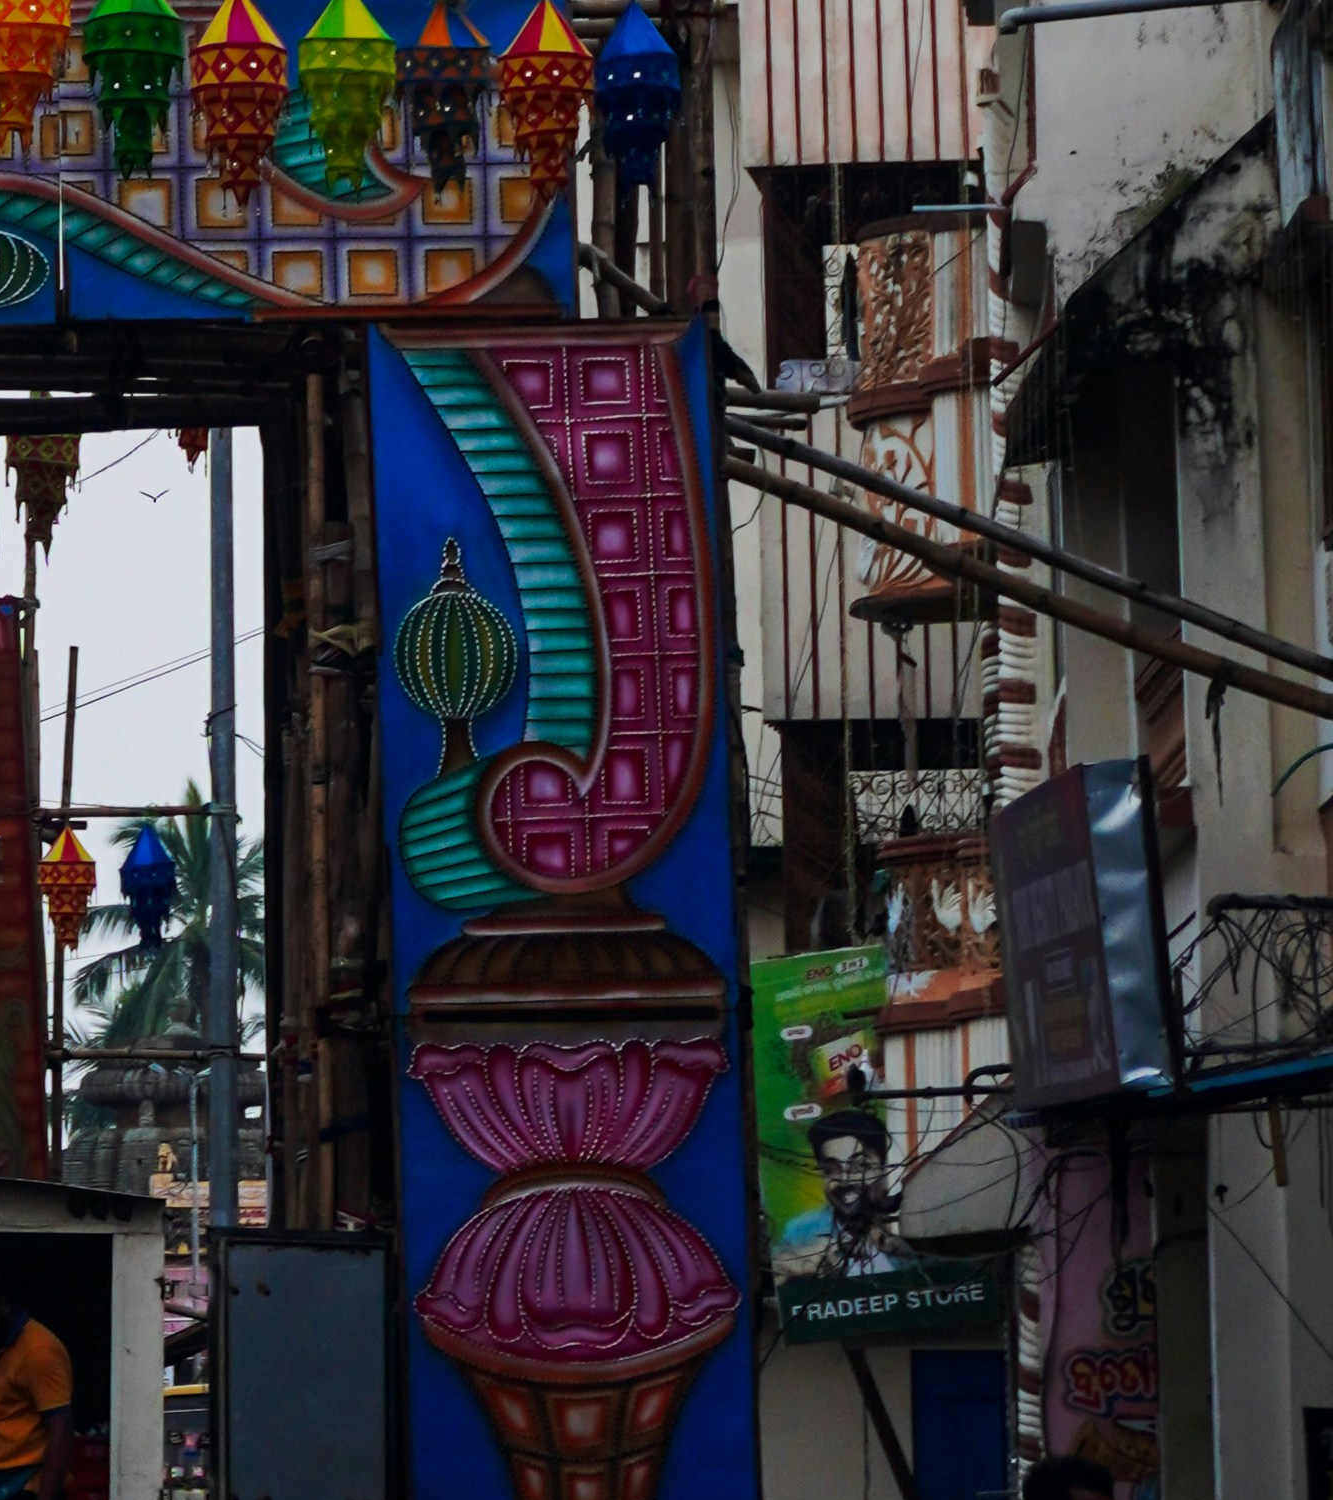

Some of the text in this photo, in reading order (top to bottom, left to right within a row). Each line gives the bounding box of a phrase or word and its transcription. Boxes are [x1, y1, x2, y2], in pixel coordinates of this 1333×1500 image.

[805, 966, 833, 981] ENO
[829, 1043, 864, 1072] ENO
[790, 1283, 986, 1321] PRADEEP STORE
